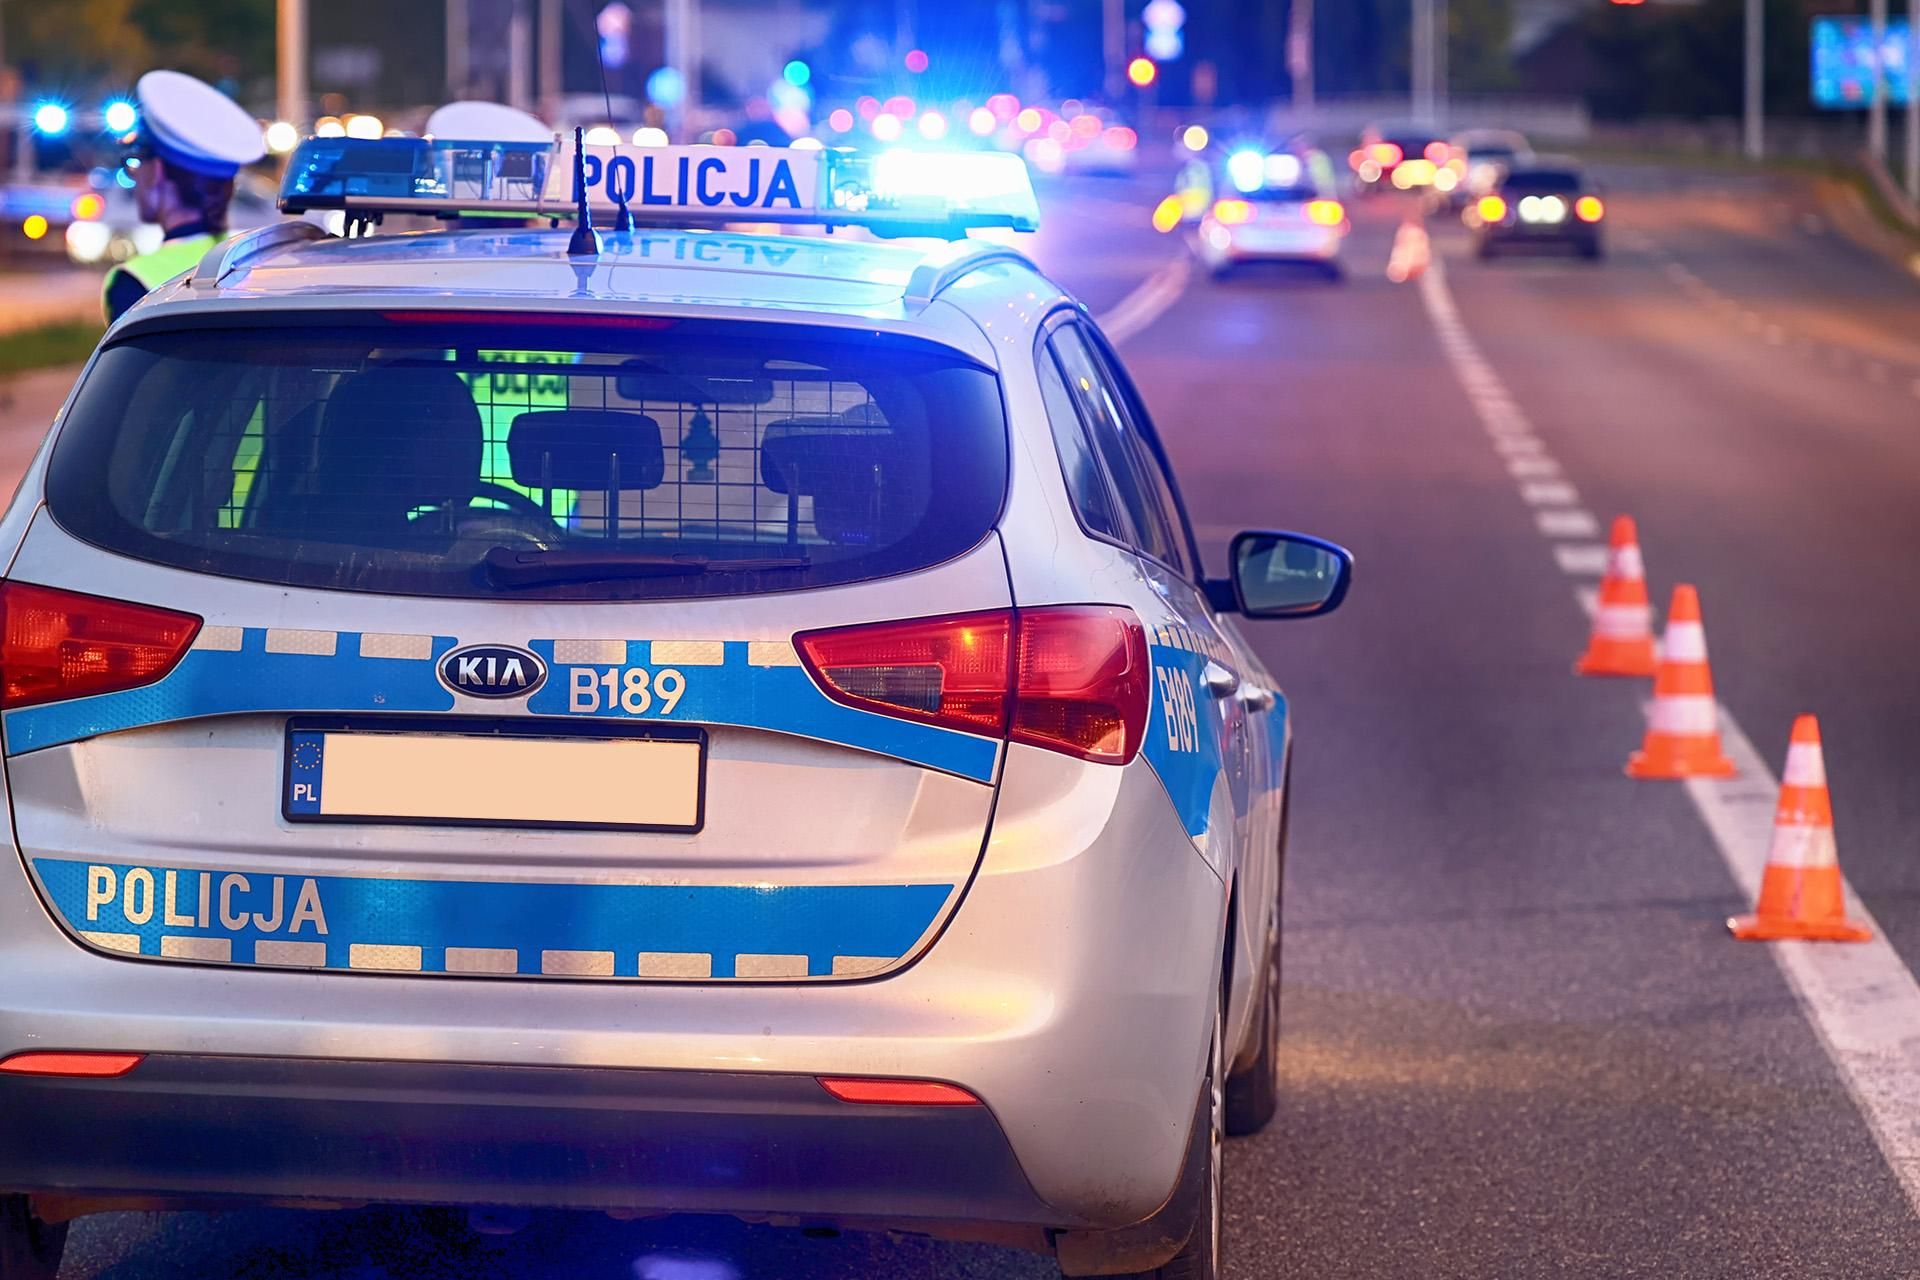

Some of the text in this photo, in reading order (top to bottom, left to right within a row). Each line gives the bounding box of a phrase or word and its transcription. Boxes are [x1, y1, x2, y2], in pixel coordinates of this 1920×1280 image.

[572, 154, 801, 208] POLICJA
[458, 657, 527, 686] KIA
[569, 667, 686, 714] B189
[1156, 666, 1199, 752] B189
[293, 783, 317, 801] PL
[87, 865, 328, 935] POLICJA
